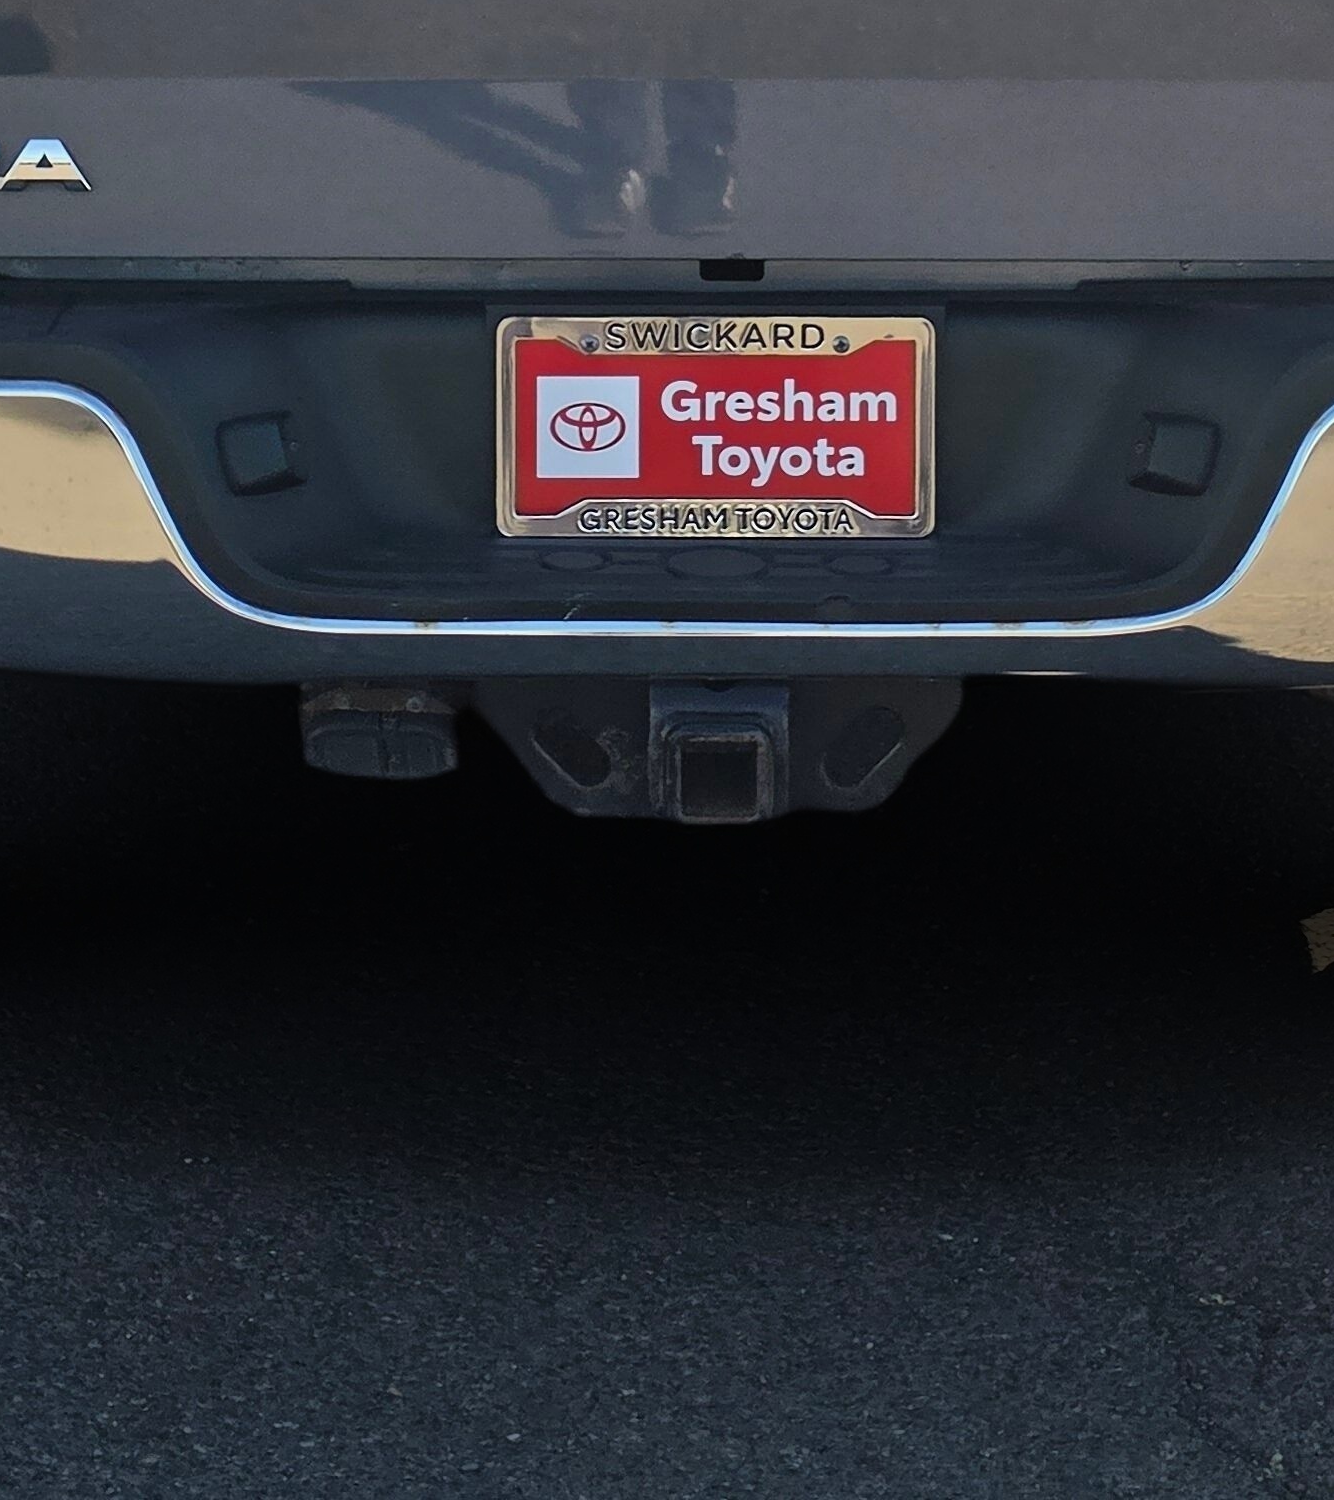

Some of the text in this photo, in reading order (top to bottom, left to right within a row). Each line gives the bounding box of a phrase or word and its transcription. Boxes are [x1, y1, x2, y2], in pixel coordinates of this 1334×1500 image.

[605, 321, 826, 353] SWICKARD
[661, 378, 898, 423] Gresham
[692, 435, 866, 488] Toyota
[578, 506, 856, 534] GRESHAM TOYOTA
